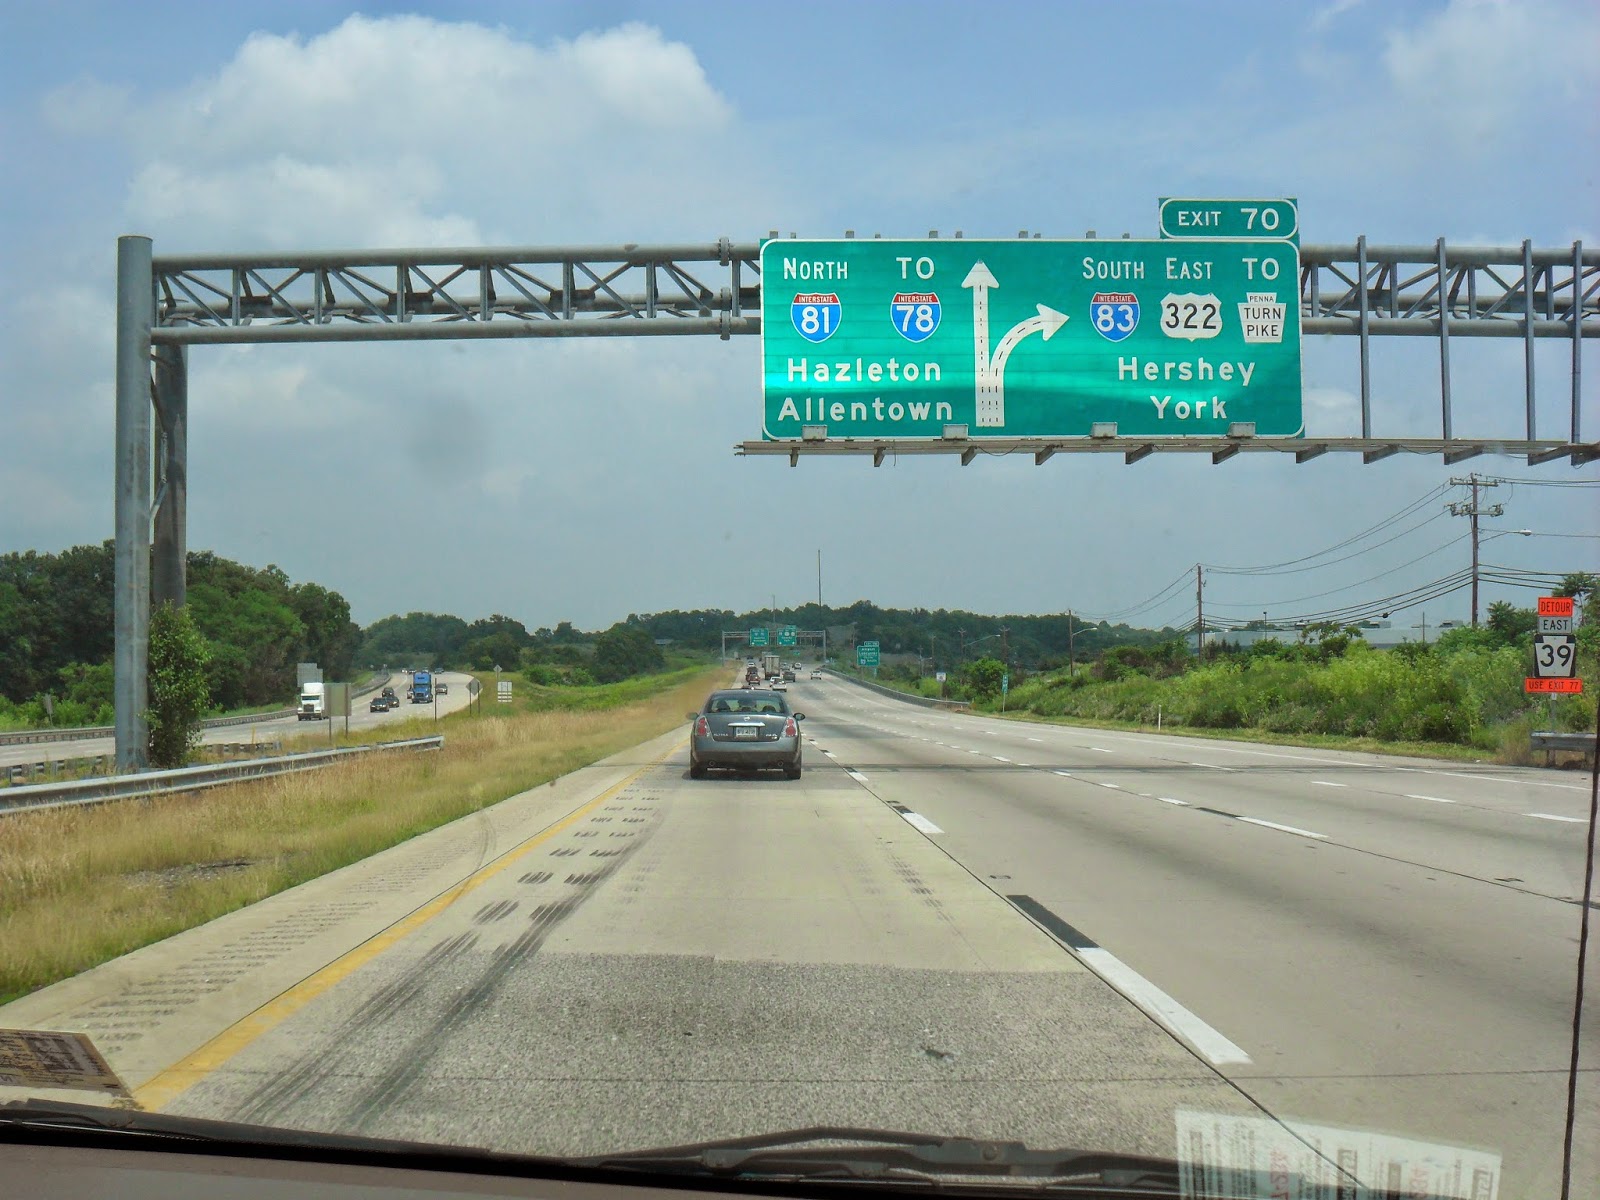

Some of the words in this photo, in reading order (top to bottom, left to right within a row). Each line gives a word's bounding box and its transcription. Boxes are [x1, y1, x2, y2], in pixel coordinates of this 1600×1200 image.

[1178, 211, 1222, 226] EXIT
[1240, 208, 1280, 231] 70
[783, 257, 848, 280] NORTH
[896, 256, 935, 280] TO
[1082, 256, 1145, 280] SOUTH
[1166, 257, 1213, 280] EAST
[1242, 257, 1280, 280] TO
[798, 295, 834, 304] INTERSTATE
[898, 294, 933, 303] INTERSTATE
[1097, 294, 1132, 303] INTERSTATE
[1249, 295, 1275, 303] PENNA
[801, 306, 830, 334] 81
[896, 305, 934, 333] 78
[1096, 304, 1134, 332] 83
[1165, 303, 1217, 330] 322
[1244, 307, 1281, 320] TURN
[1246, 324, 1279, 337] PIKE
[787, 357, 941, 382] Hazleton
[1118, 357, 1256, 387] Hershey
[777, 397, 953, 421] Allentown
[1150, 395, 1227, 419] York
[1541, 602, 1571, 613] DETOUR
[1543, 619, 1568, 631] EAST
[1540, 644, 1571, 667] 39
[1529, 681, 1543, 690] USE
[1549, 681, 1564, 690] EXIT
[1569, 681, 1579, 690] 77
